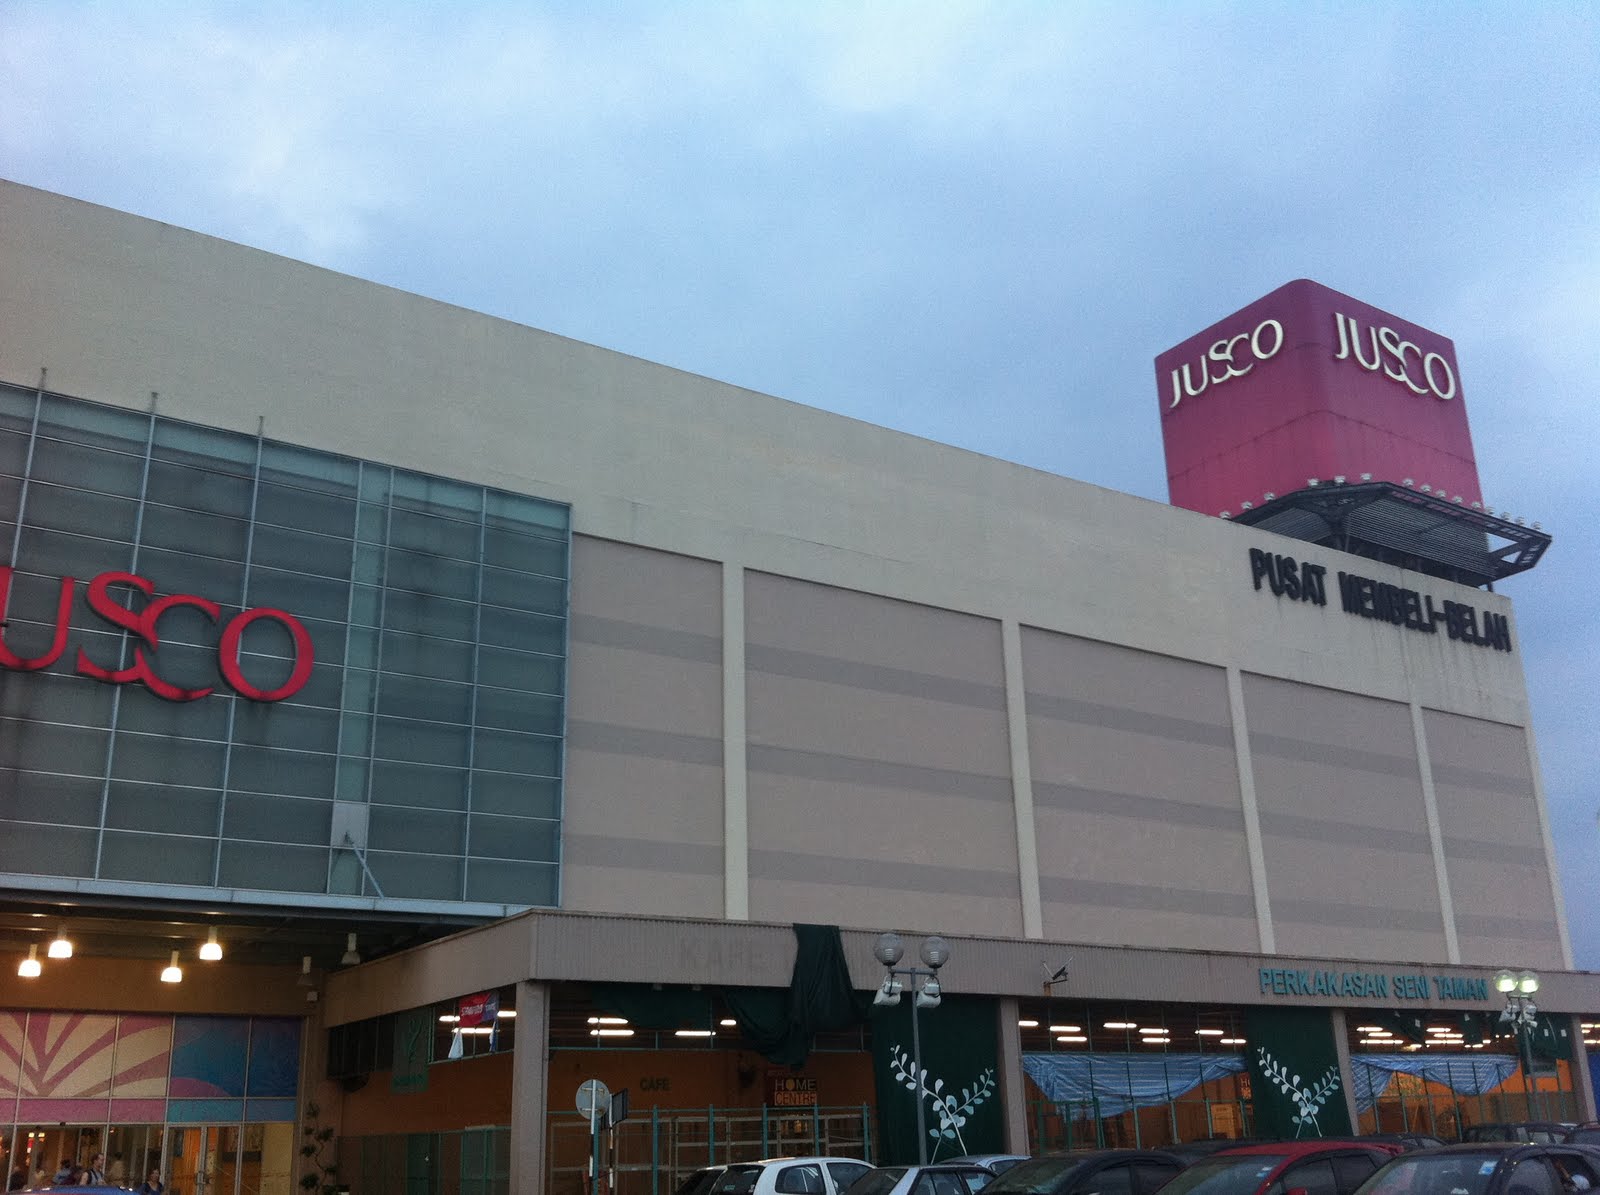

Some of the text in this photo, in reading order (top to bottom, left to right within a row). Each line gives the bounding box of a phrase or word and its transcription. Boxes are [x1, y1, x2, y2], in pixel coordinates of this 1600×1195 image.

[1169, 319, 1284, 409] JUSCO
[1335, 312, 1456, 401] JUSCO
[1249, 547, 1328, 607] PUSAT
[1258, 967, 1489, 1001] PERKAKASAN SENI TAMAN
[775, 1079, 817, 1091] HOME
[775, 1091, 816, 1105] CENTRE
